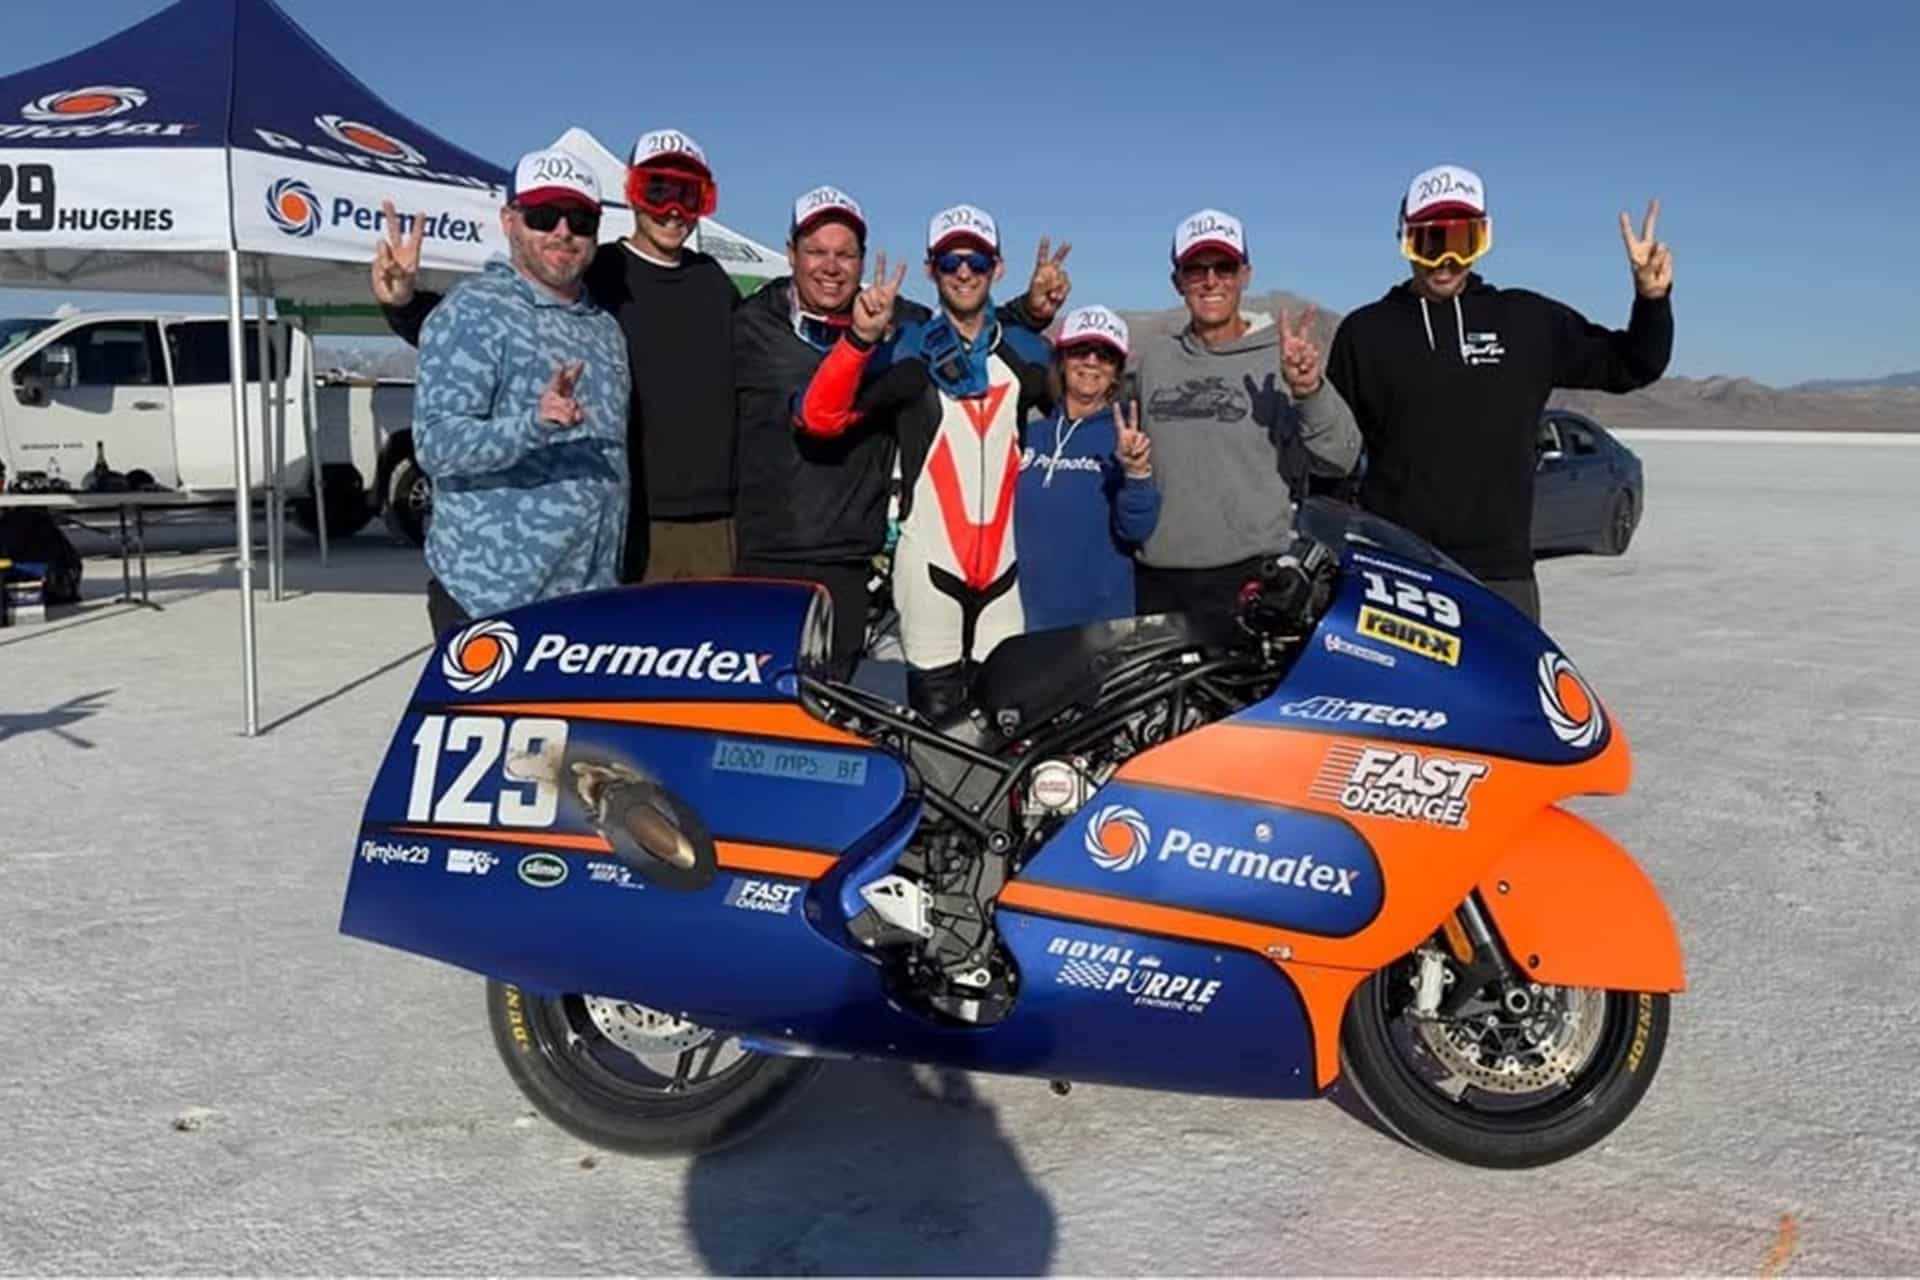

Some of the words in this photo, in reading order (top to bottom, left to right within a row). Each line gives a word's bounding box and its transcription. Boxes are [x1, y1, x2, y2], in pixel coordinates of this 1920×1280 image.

[58, 208, 174, 231] HUGHES
[1363, 571, 1461, 628] 129
[523, 634, 772, 683] Permatex
[407, 716, 569, 826] 129
[1350, 748, 1486, 799] FAST
[1341, 785, 1465, 824] ORANGE
[1158, 828, 1360, 896] Permatex
[741, 881, 801, 902] FAST
[1048, 937, 1134, 966] ROYAL
[1105, 967, 1222, 1005] PURPLE
[1629, 991, 1652, 1073] UNLOP
